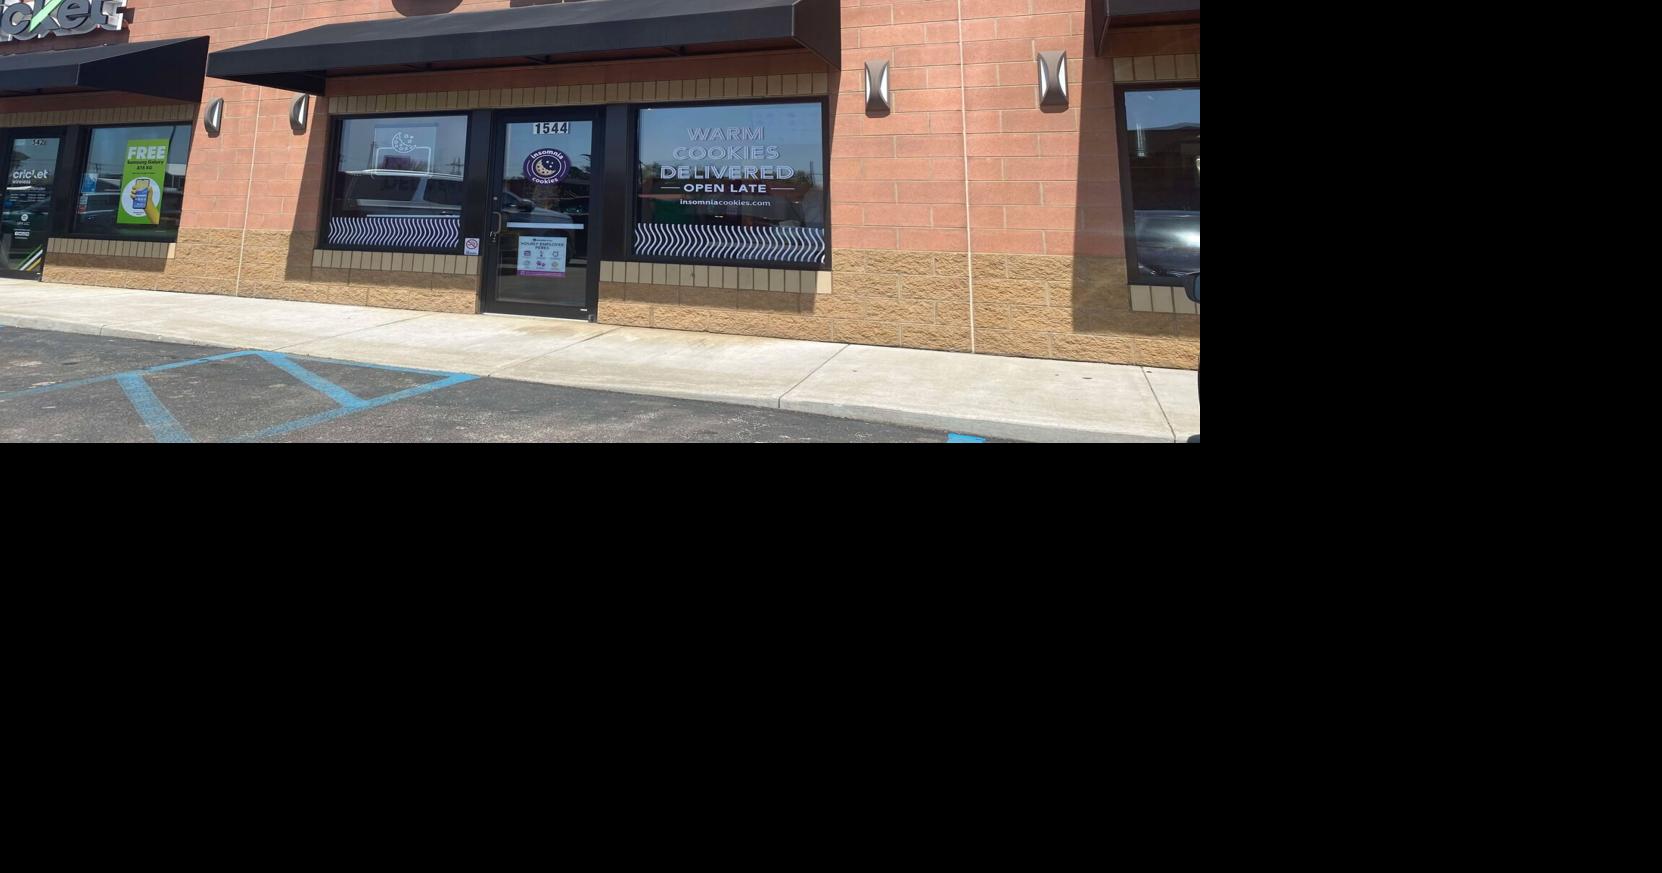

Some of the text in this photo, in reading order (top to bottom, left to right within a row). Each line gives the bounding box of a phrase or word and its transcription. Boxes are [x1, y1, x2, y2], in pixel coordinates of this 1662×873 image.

[535, 122, 568, 134] 1544
[687, 127, 765, 141] WARM
[127, 146, 166, 160] FREE
[530, 150, 564, 160] insomnia
[672, 145, 781, 160] COOKIES
[660, 165, 795, 180] DELIVERED
[683, 183, 767, 193] OPEN LATE
[679, 198, 771, 207] insomniacookies.com
